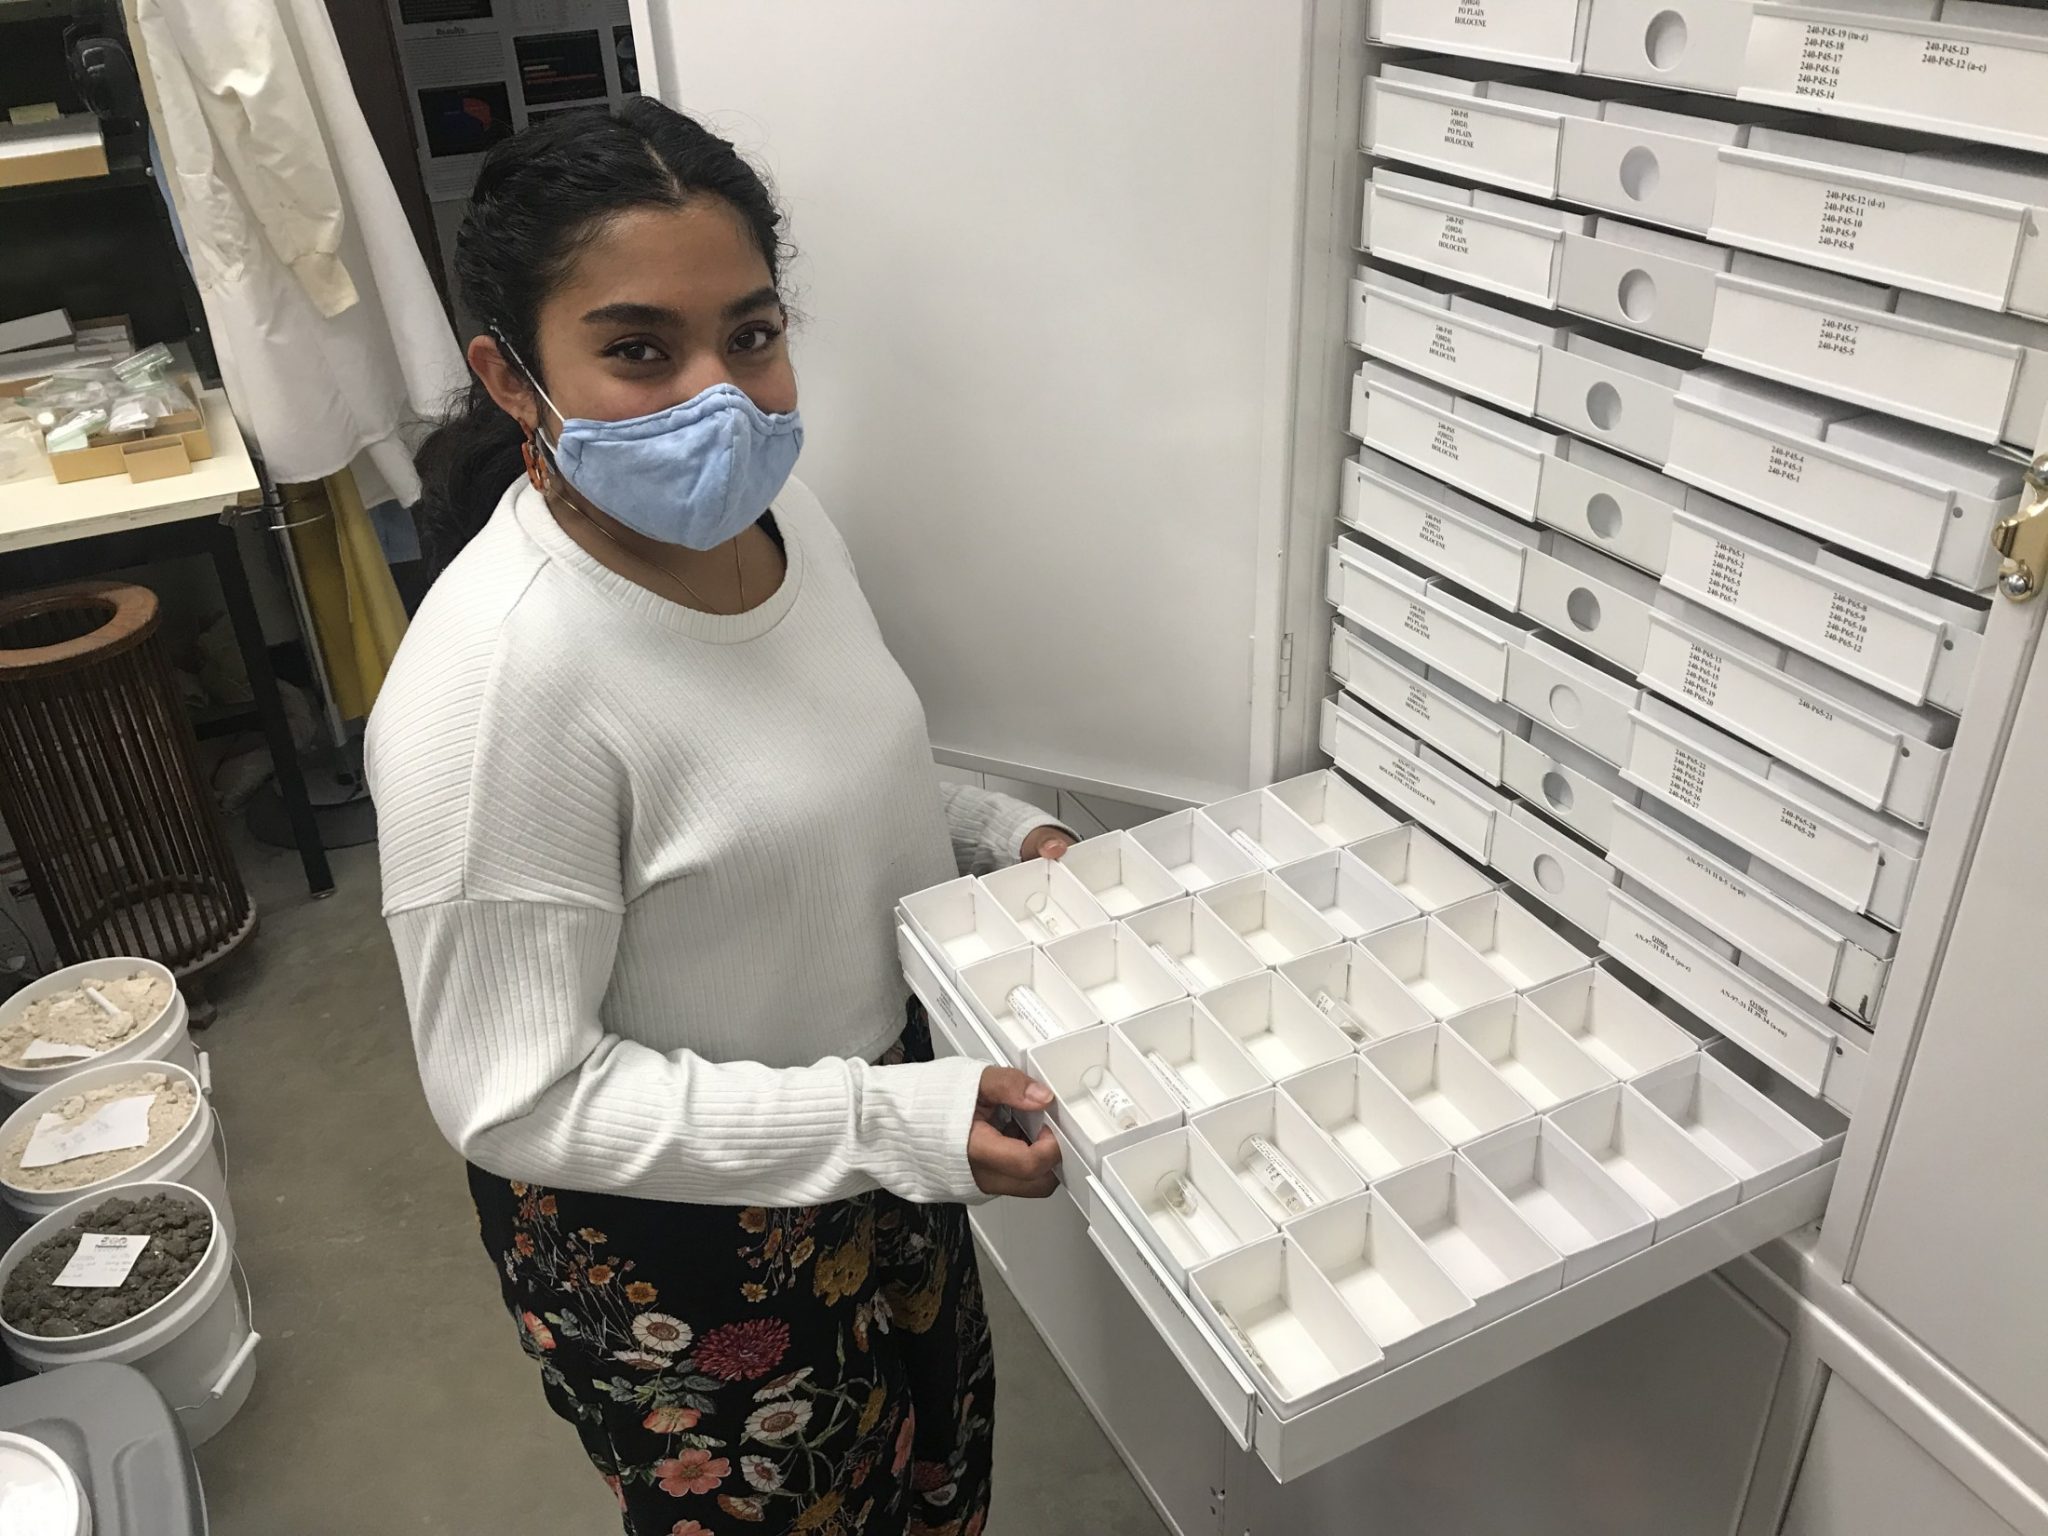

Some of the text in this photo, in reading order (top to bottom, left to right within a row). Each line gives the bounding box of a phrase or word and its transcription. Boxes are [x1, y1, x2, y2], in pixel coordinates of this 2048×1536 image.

[1467, 7, 1485, 16] PLAIN
[1454, 16, 1487, 27] HOLOCENE
[1806, 25, 1847, 38] 240-P45-19
[1804, 37, 1845, 50] 240-P45-18
[1925, 41, 1970, 55] 240-P45-13
[1802, 49, 1843, 62] 240-P45-17
[1922, 54, 1966, 69] 240-P45-12
[1800, 61, 1840, 75] 240-P45-16
[1797, 73, 1838, 87] 240-P45-15
[1826, 190, 1866, 205] 240-P45-12
[1824, 201, 1864, 216] 240-P45-11
[1822, 213, 1863, 228] 240-P45-10
[1820, 224, 1857, 238] 240-P45-9
[1818, 235, 1855, 251] 240-P45-8
[1821, 318, 1859, 333] 240-P45-7
[1819, 329, 1857, 345] 240-P45-6
[1818, 340, 1855, 356] 240-P45-5
[1768, 465, 1800, 483] 240-P45-1
[1716, 541, 1745, 560] 240-P65-1
[1714, 550, 1744, 569] 240-P65-2
[1710, 568, 1741, 587] 240-P65-5
[1826, 620, 1864, 643] 240-P65-11
[1824, 630, 1862, 653] 240-P65-12
